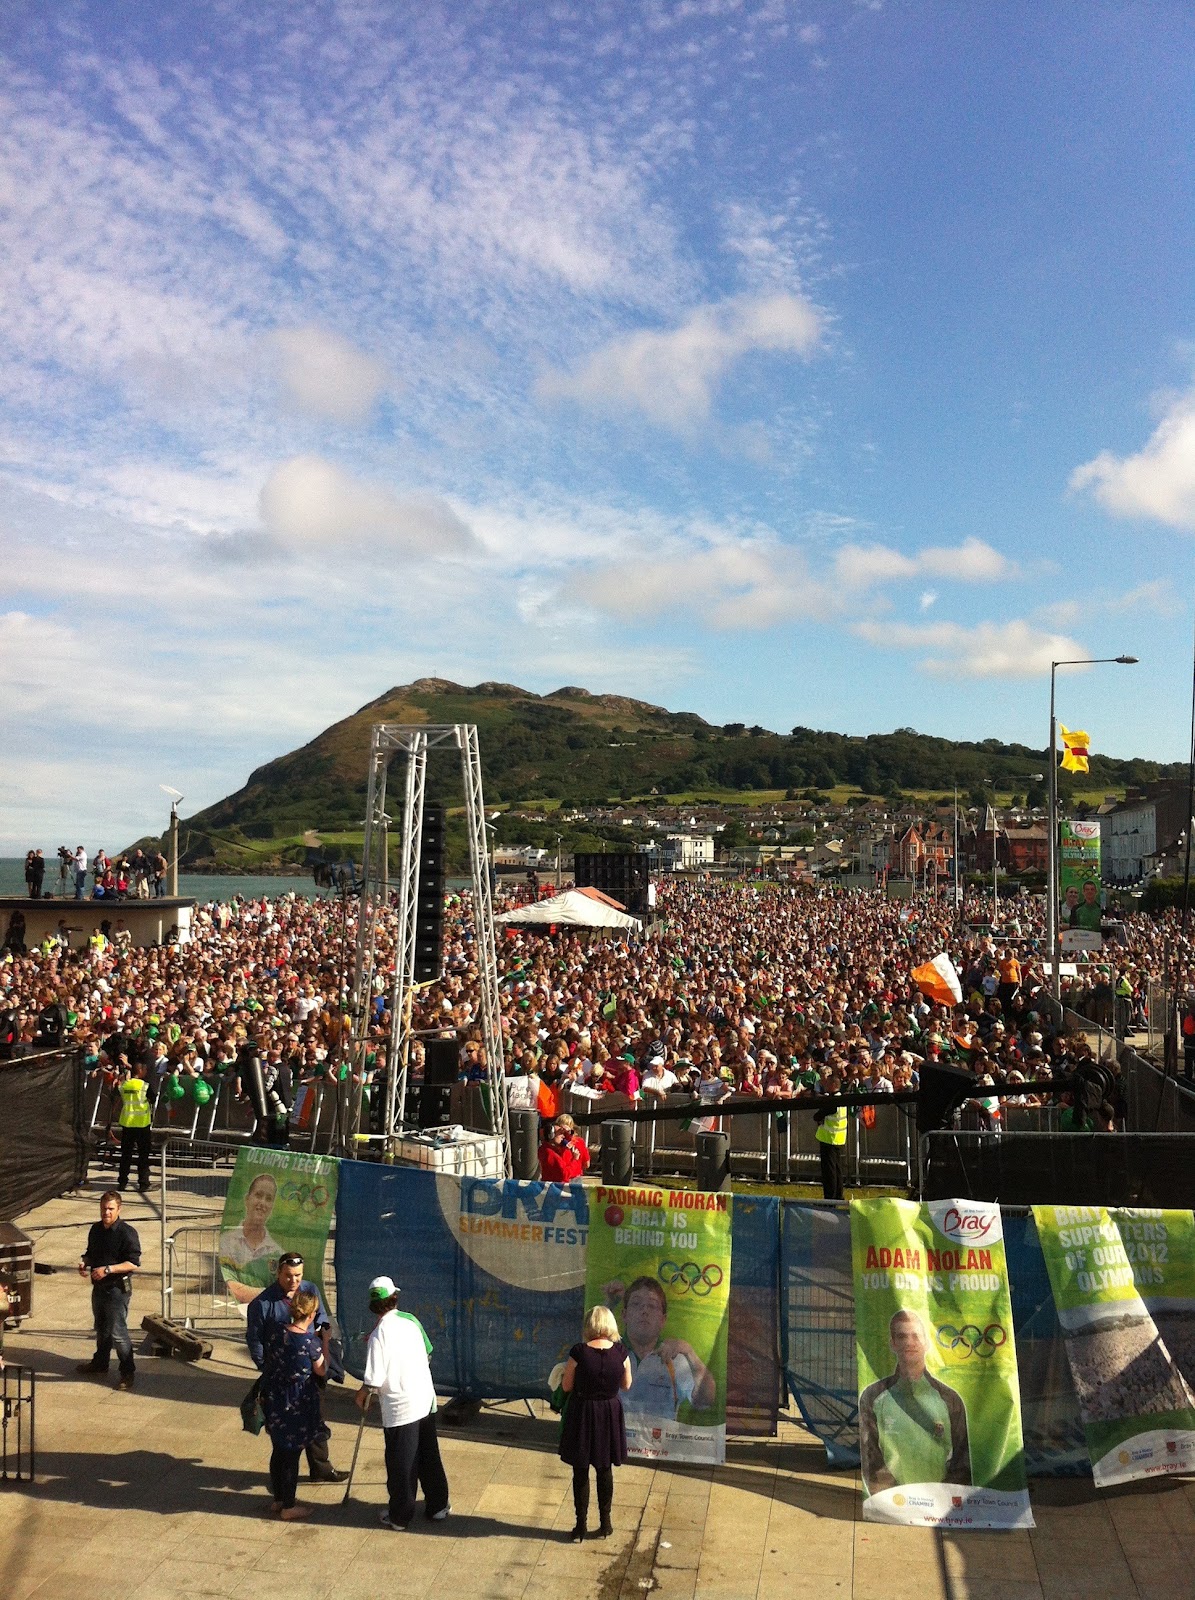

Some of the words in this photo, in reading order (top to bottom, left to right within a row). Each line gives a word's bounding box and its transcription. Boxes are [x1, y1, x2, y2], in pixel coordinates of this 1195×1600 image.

[247, 1148, 290, 1168] OLYMPIC
[460, 1176, 590, 1225] BRA
[596, 1187, 663, 1207] PADRAIC
[669, 1190, 727, 1211] MORAN
[631, 1208, 668, 1227] BRAY
[673, 1212, 687, 1229] IS
[944, 1208, 997, 1239] Bray
[1054, 1207, 1101, 1226] BRAY
[615, 1228, 665, 1247] BEHIND
[670, 1231, 698, 1250] YOU
[866, 1245, 920, 1270] ADAM
[927, 1248, 993, 1271] NOLAN
[1065, 1249, 1086, 1271] OF
[1093, 1245, 1129, 1266] OUR
[1128, 1242, 1169, 1264] 2012
[862, 1273, 890, 1290] YOU
[895, 1273, 920, 1291] DID
[923, 1274, 944, 1292] US
[950, 1273, 1000, 1291] PROUD
[1077, 1266, 1165, 1292] OLYMPANS
[924, 1515, 973, 1525] www.bray.ie
